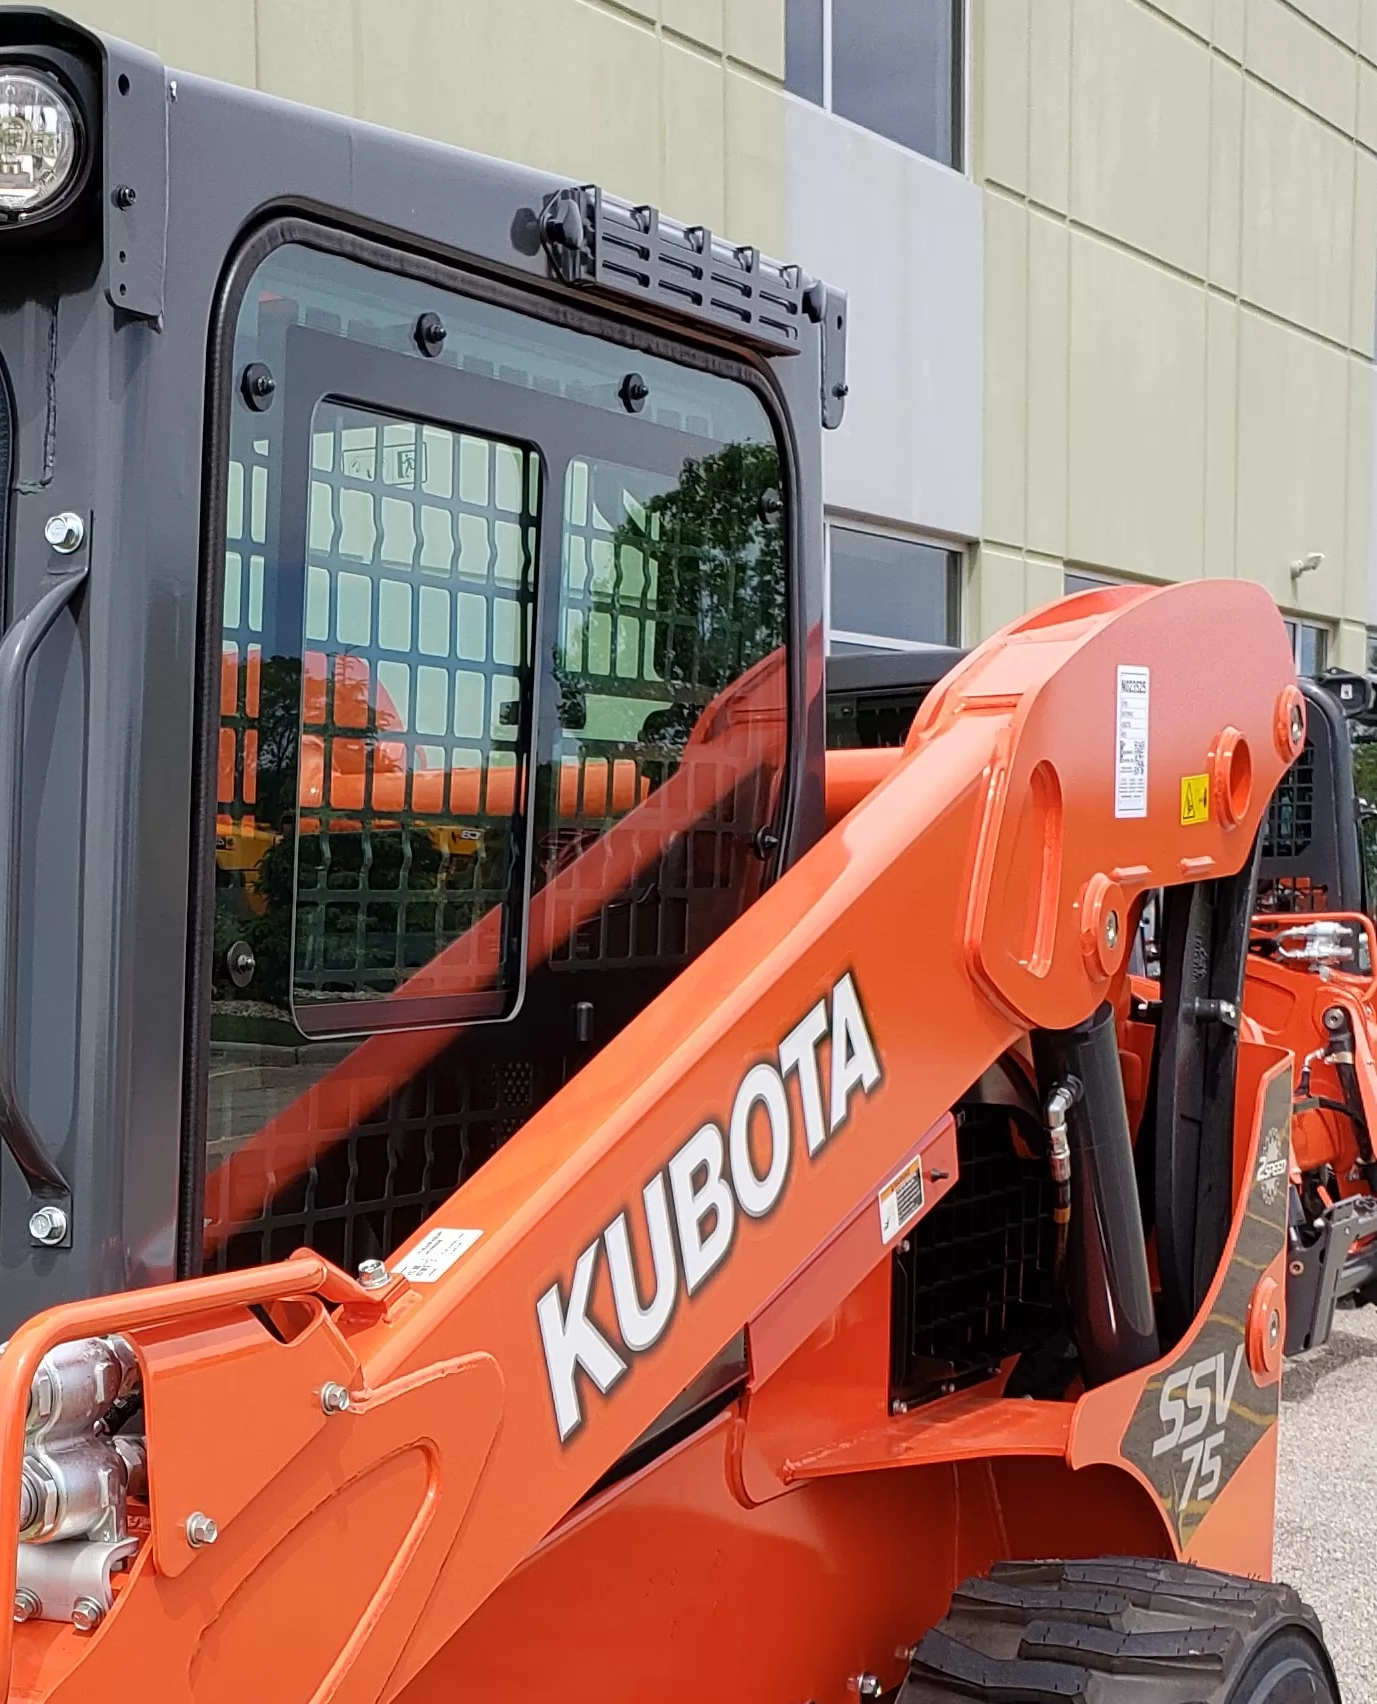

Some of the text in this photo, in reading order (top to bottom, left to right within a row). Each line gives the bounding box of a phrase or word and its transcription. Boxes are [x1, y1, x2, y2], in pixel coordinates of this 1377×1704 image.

[537, 973, 881, 1443] KUBOTA
[1152, 1343, 1244, 1457] SSV
[1177, 1430, 1226, 1512] 75
